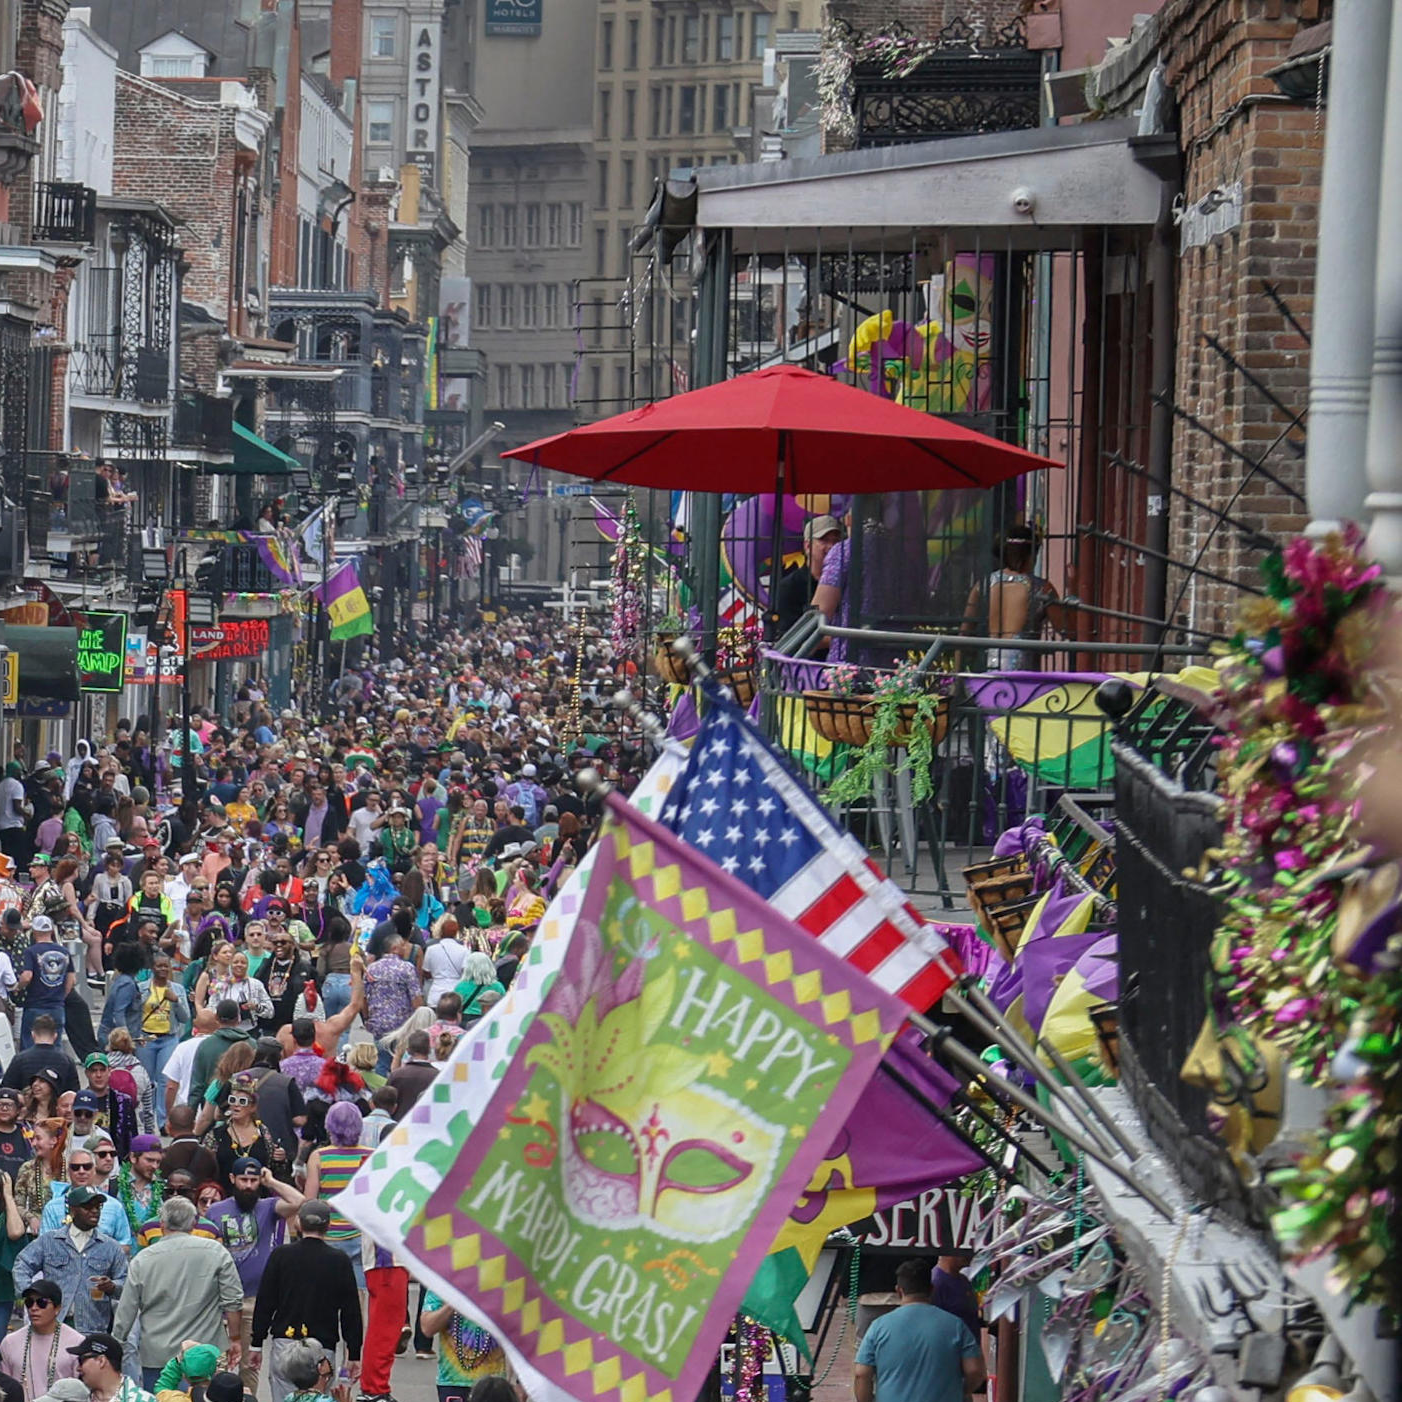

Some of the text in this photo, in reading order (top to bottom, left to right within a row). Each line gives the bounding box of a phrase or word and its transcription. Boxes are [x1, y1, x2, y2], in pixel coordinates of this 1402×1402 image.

[414, 28, 432, 149] ASTOR
[670, 967, 835, 1099] HAPPY
[470, 1158, 696, 1362] MARDI GRAS!
